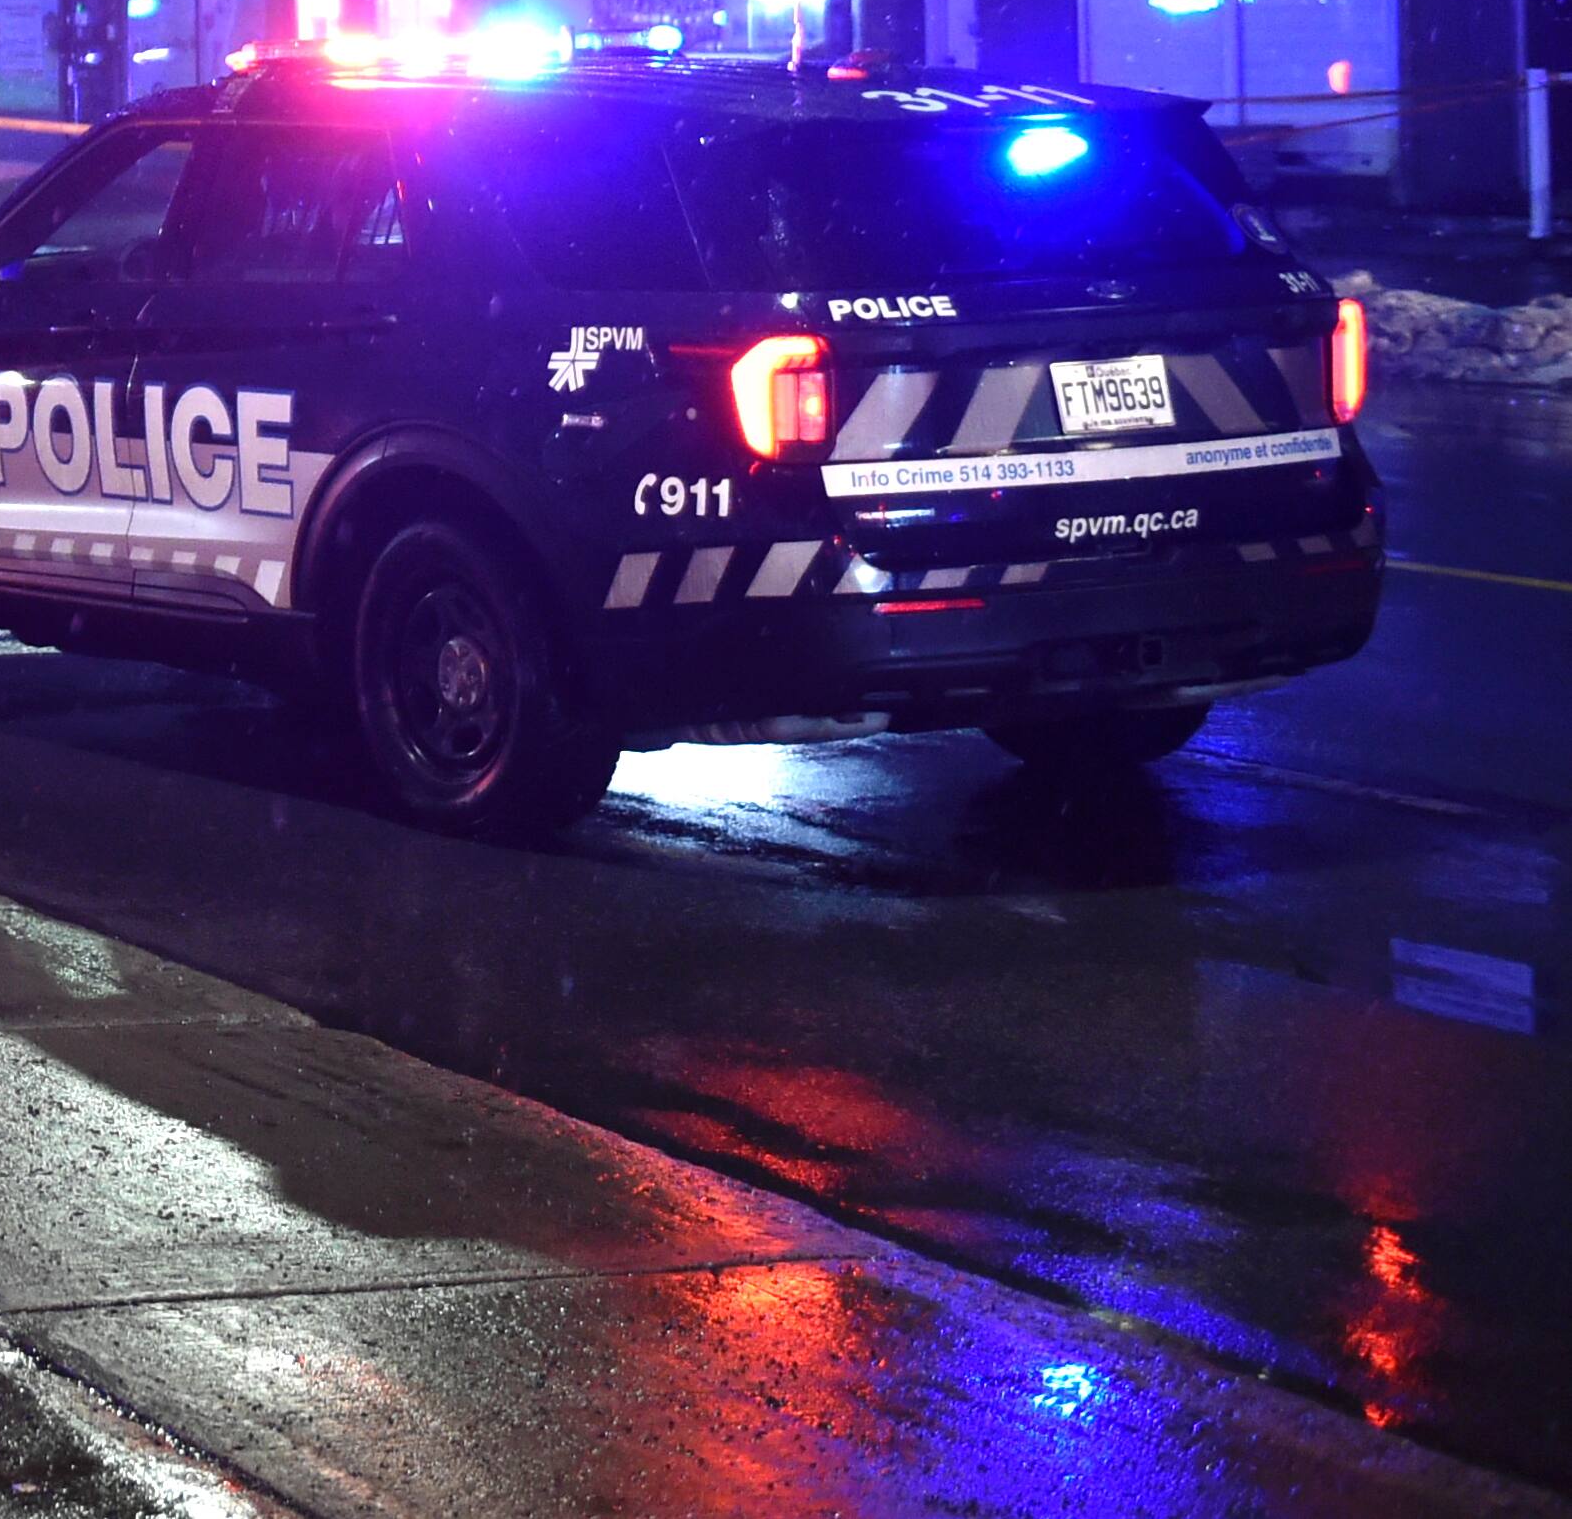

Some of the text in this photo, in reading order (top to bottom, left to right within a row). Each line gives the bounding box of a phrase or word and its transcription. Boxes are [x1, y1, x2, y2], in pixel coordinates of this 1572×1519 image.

[861, 84, 1095, 114] 31-11
[828, 294, 957, 322] POLICE
[584, 326, 644, 352] SPVM
[1061, 376, 1165, 416] FTM9639
[1185, 446, 1253, 466] anonyme
[1254, 442, 1268, 459] et
[851, 459, 1075, 488] Info Crime 514 393-1133
[659, 475, 732, 518] 911
[1054, 507, 1200, 544] spvm.qc.ca
